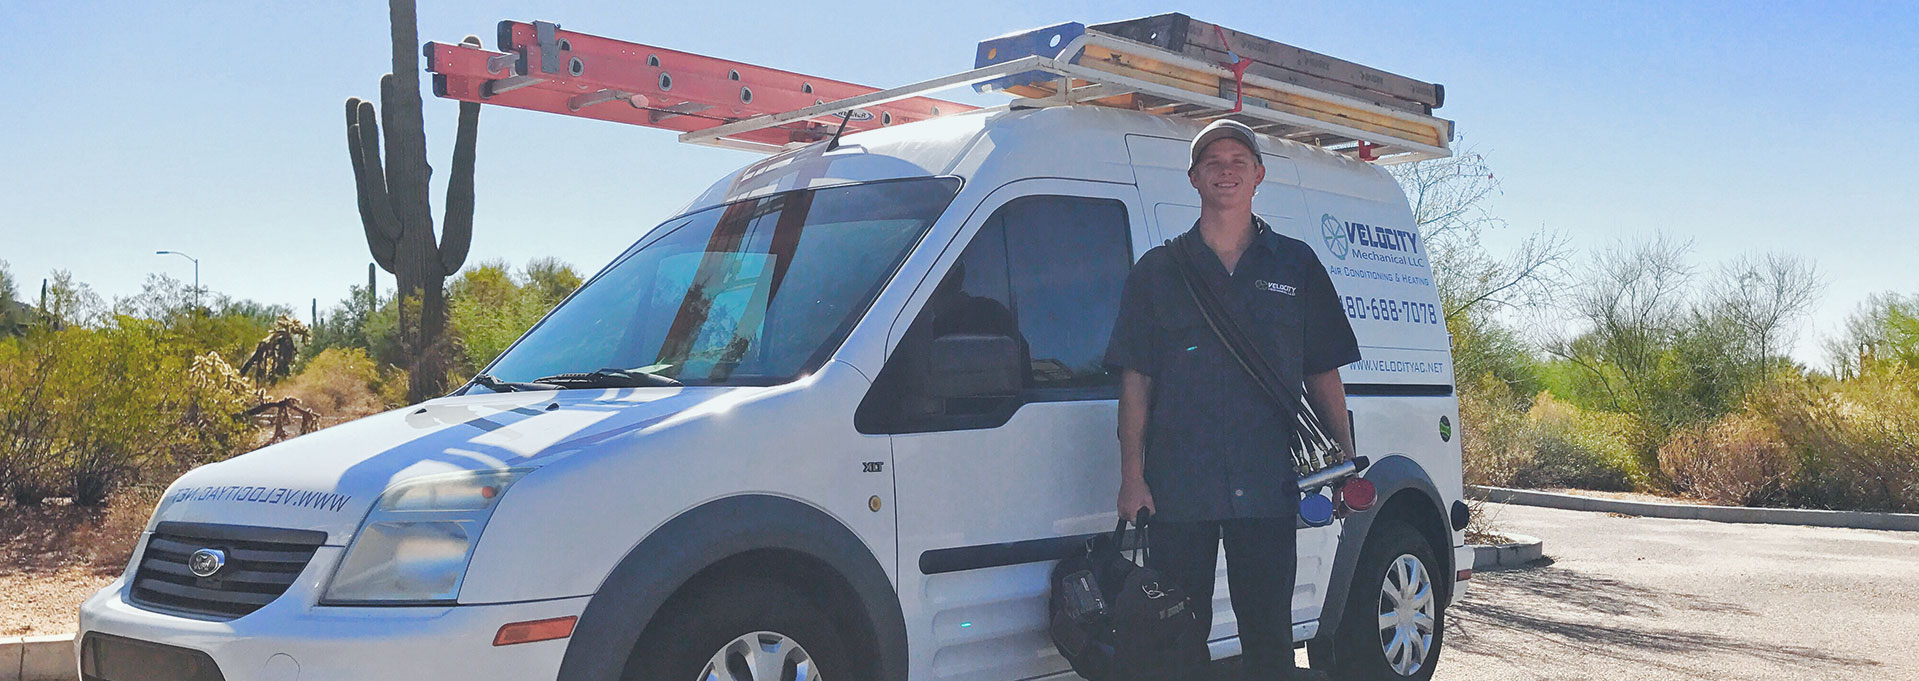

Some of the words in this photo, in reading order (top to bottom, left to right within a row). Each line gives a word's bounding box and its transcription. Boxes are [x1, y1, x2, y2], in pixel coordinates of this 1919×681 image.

[838, 110, 866, 119] WENER
[1344, 221, 1417, 254] VELOCITY
[1351, 248, 1406, 265] Mechanical
[1408, 257, 1425, 268] LLC
[1395, 273, 1400, 282] &
[1268, 282, 1296, 293] VELOCITY
[1349, 360, 1443, 373] WWW.VELOCITYAC.NET
[862, 462, 884, 472] XLT
